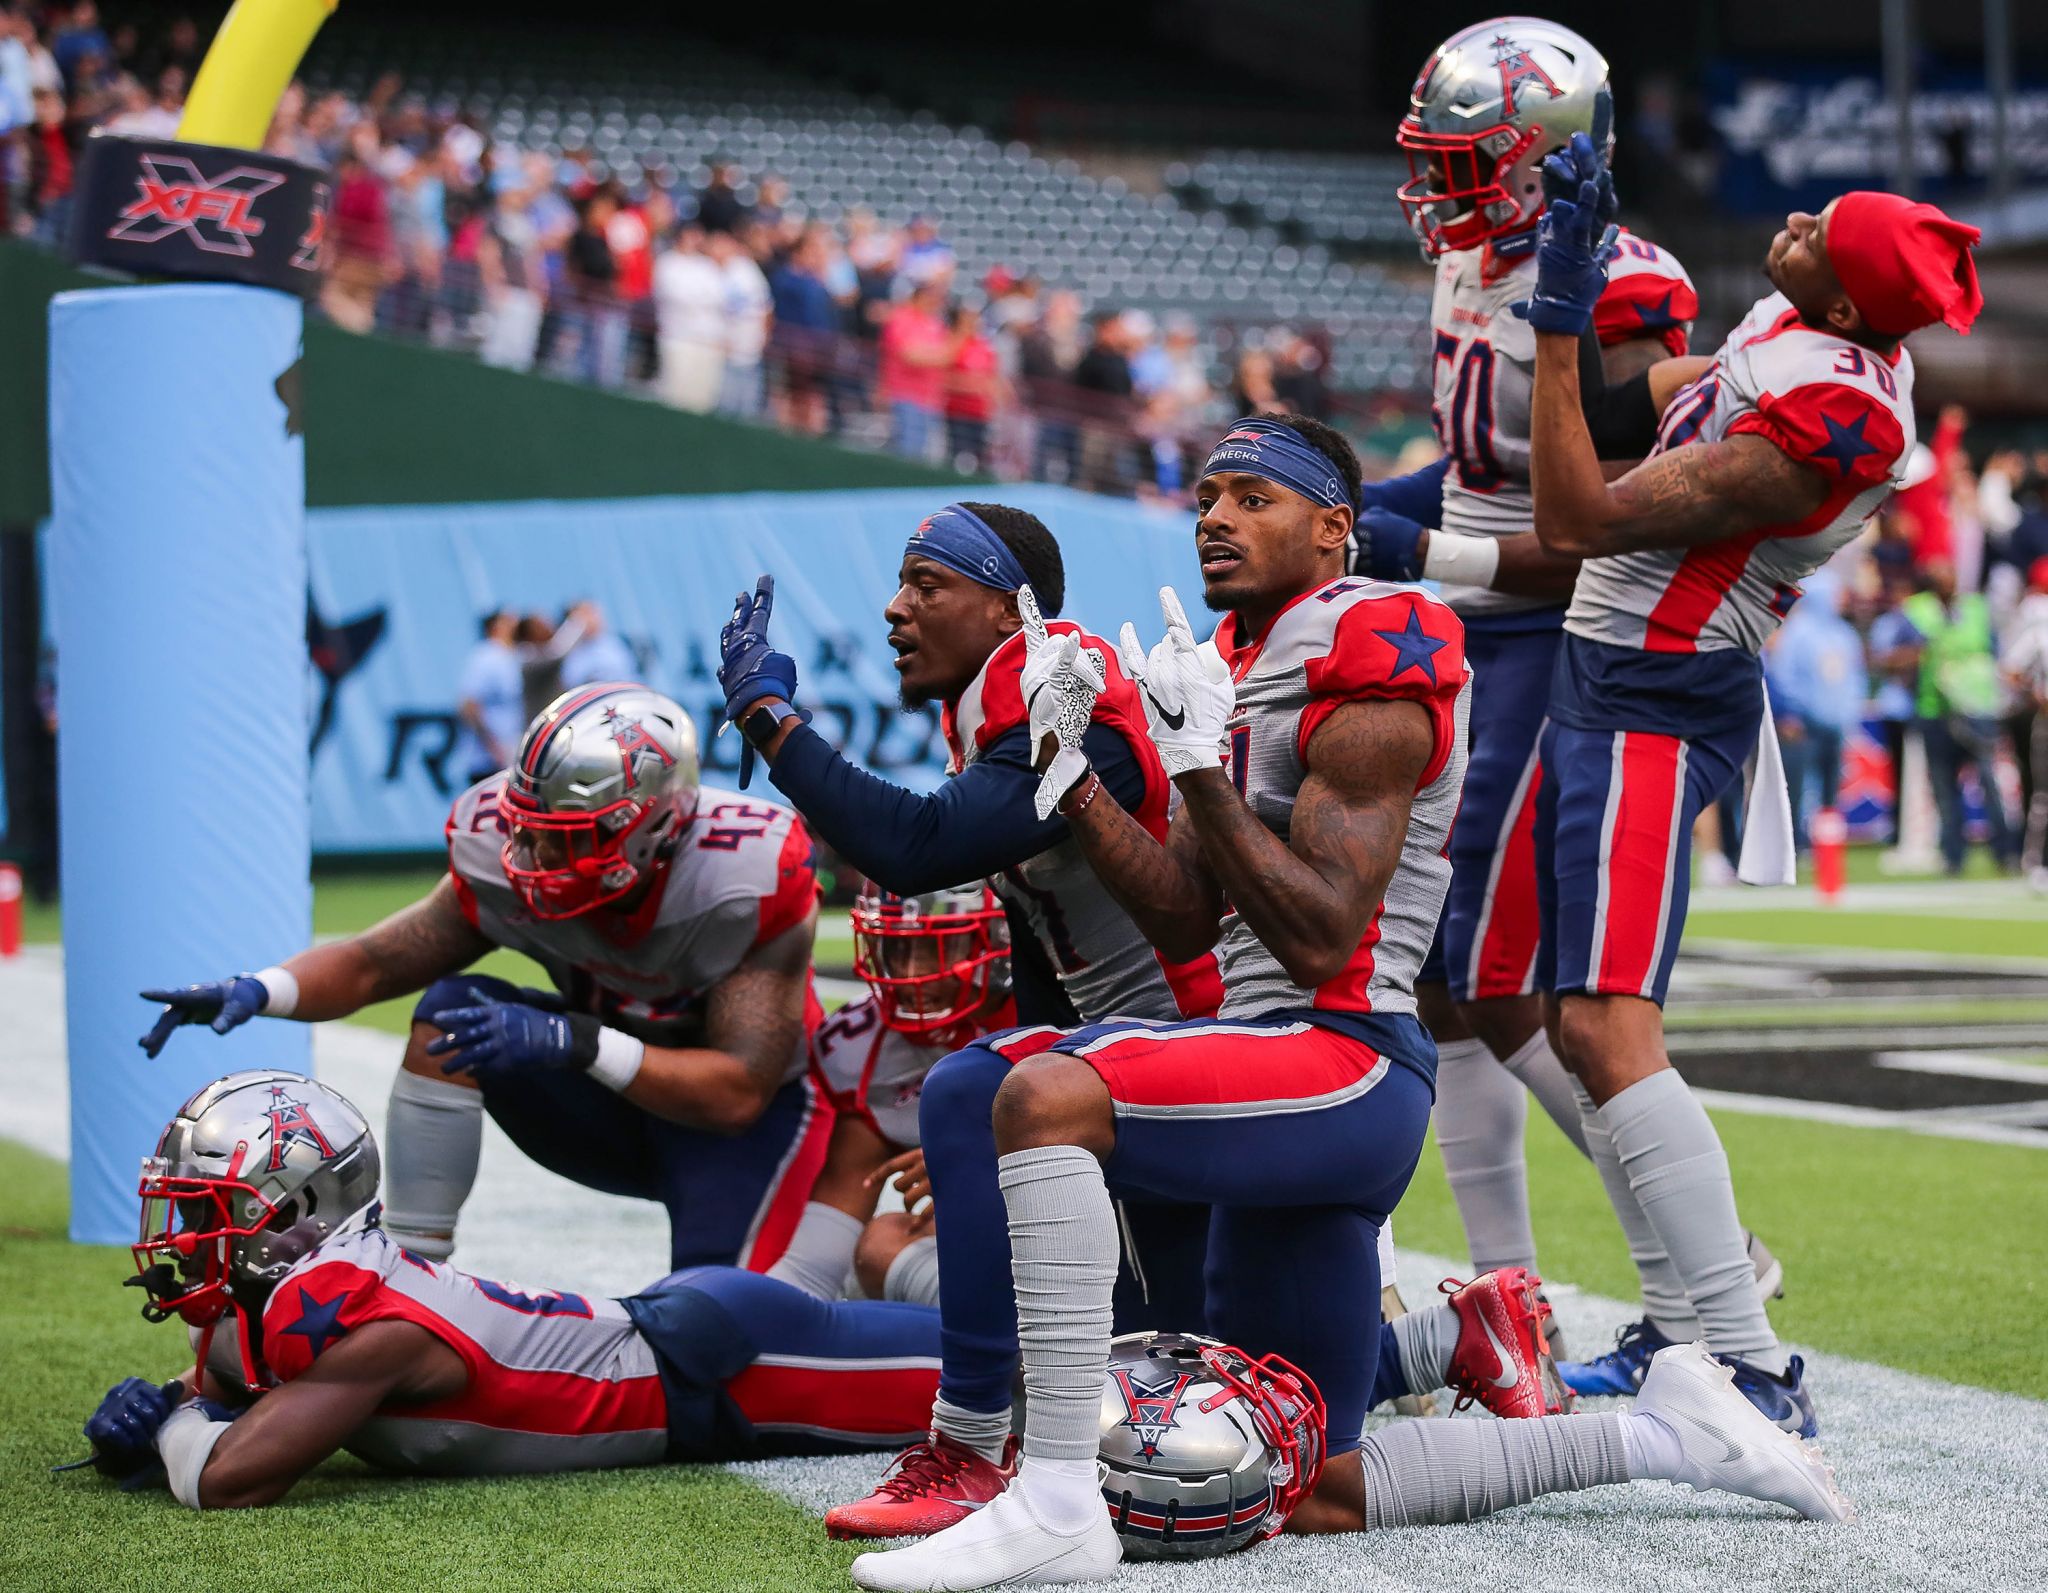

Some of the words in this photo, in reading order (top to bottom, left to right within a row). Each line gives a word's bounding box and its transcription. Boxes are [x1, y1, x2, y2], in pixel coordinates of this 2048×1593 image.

[119, 176, 267, 237] XFL
[1833, 346, 1899, 403] 30
[697, 804, 783, 853] 42
